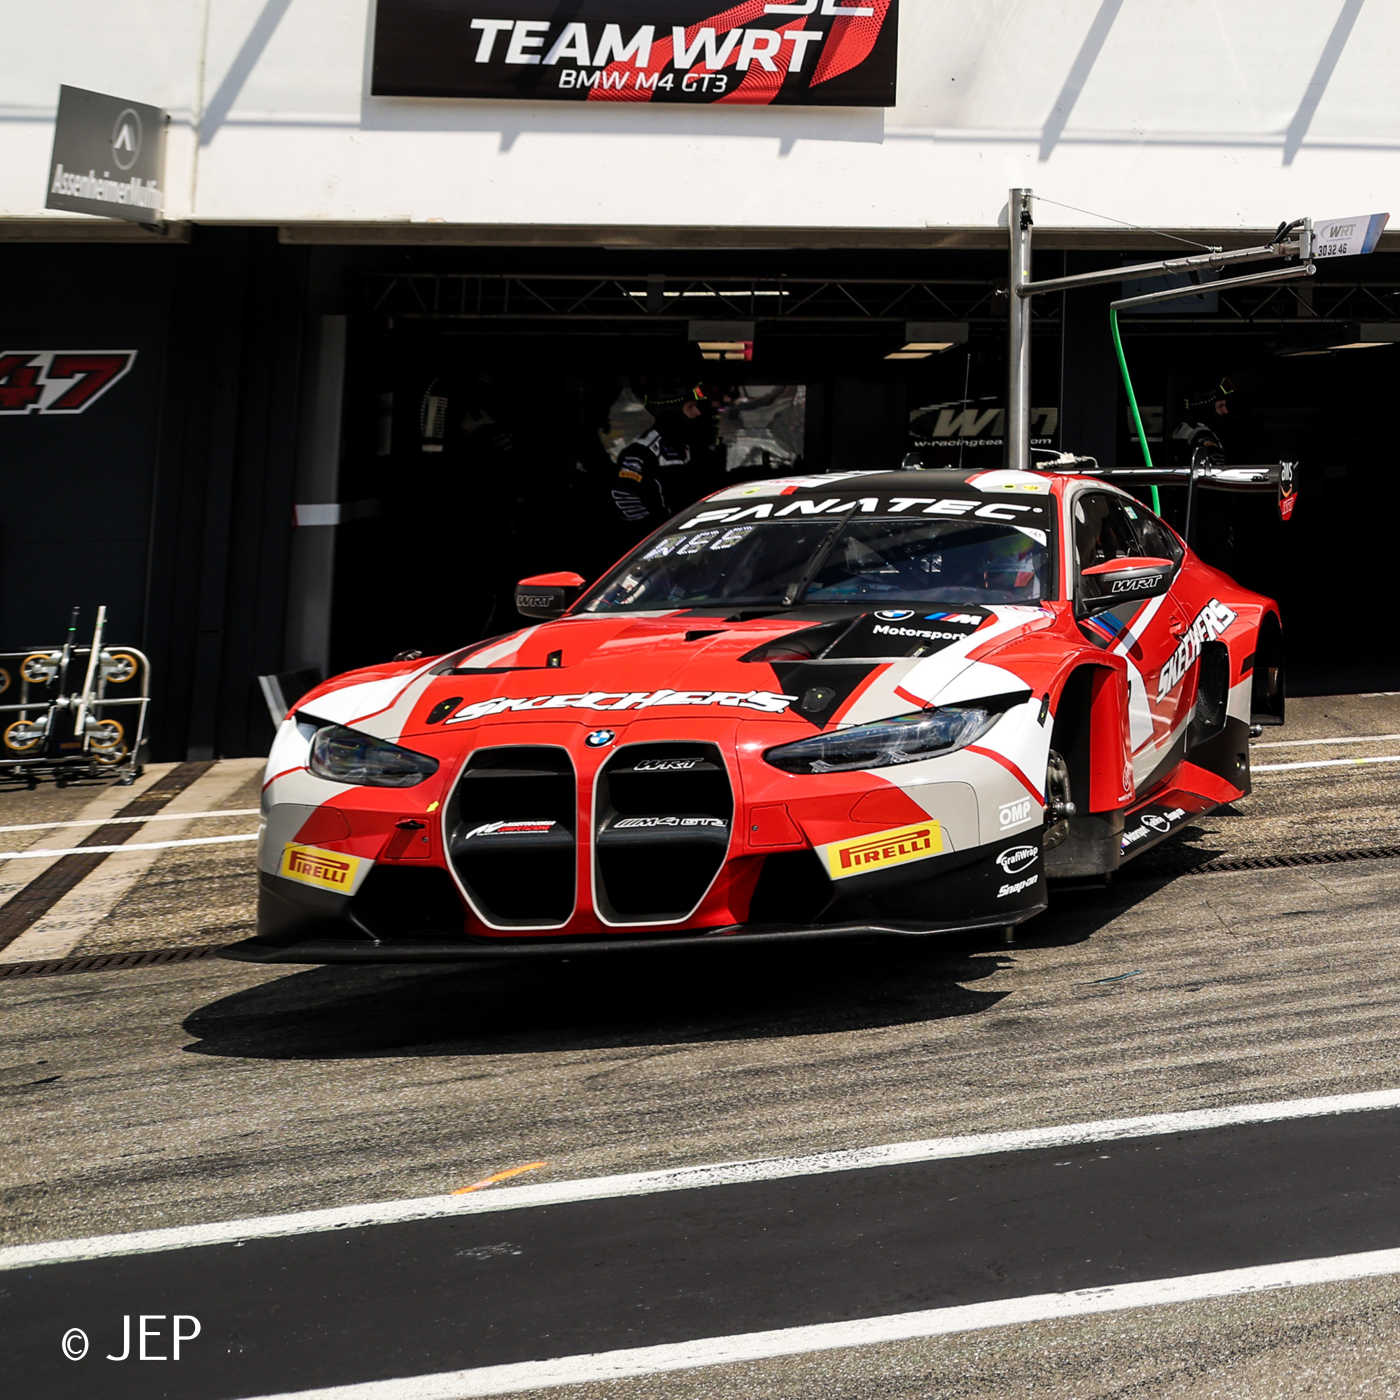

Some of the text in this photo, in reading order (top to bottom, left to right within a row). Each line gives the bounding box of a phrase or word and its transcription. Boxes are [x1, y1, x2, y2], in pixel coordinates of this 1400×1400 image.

[469, 18, 824, 73] TEAM WRT
[558, 69, 729, 93] BMW M4 GT3
[1329, 223, 1356, 238] WRT
[0, 352, 137, 413] 47
[913, 437, 1052, 448] w-racingteaom
[678, 497, 1035, 530] FANATEC
[1112, 574, 1163, 593] WRT
[516, 595, 553, 607] WRT
[873, 624, 970, 641] Motorsport
[1156, 597, 1239, 704] SKECHERS
[445, 689, 799, 724] SKECHERS
[633, 757, 704, 771] WRT
[1000, 802, 1032, 824] OMP
[839, 829, 931, 870] PIRELLI
[999, 845, 1039, 868] GrafiWrap
[288, 850, 350, 884] PIRELLI
[997, 874, 1039, 898] Snap-on
